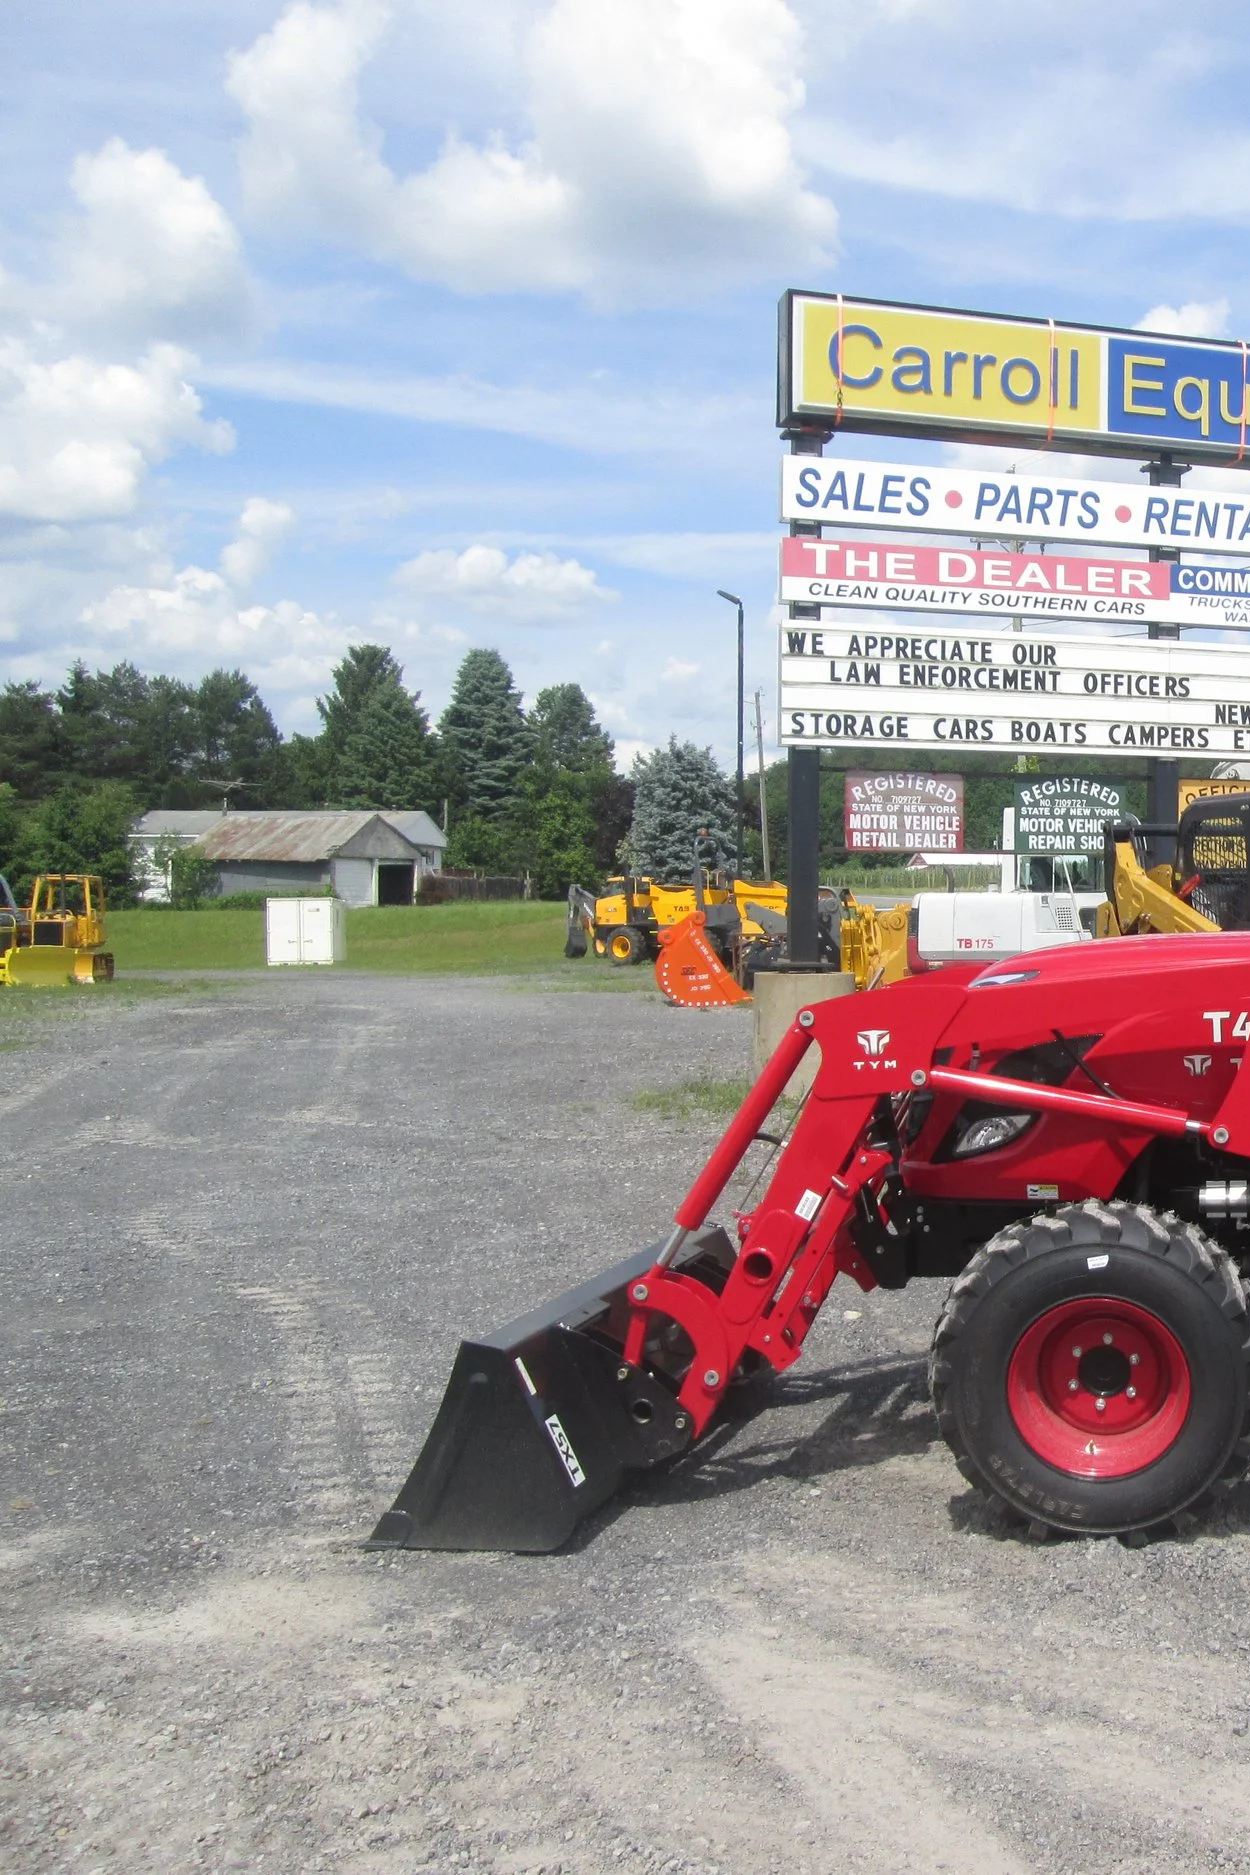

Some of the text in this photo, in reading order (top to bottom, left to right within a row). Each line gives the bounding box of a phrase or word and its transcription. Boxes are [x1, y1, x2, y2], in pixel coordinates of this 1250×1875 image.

[828, 324, 1078, 409] Carroll
[795, 467, 931, 516] SALES
[974, 482, 1100, 530] PARTS
[802, 542, 1152, 596] THE DEALER
[808, 582, 1145, 615] CLEAN QUALITY SOUTHERN CARS
[787, 631, 1057, 665] WE APPRECIATE OUR
[830, 660, 1190, 698] LAW ENFORCEMENT OFFICERS
[791, 712, 909, 738] STORAGE
[933, 717, 993, 741] CARS
[1011, 720, 1087, 744] BOATS
[1108, 724, 1210, 748] CAMPERS
[851, 773, 957, 802] REGISTERED
[1020, 777, 1120, 806] REGISTERED
[891, 795, 921, 803] 7109727
[1054, 799, 1087, 808] 7109727
[851, 803, 957, 814] STATE OF NEW YORK
[1021, 807, 1120, 817] STATE OF NEW YORK
[849, 813, 960, 831] MOTOR VEHICLE
[1019, 817, 1064, 833] MOTOR
[852, 831, 957, 848] RETAIL DEALER
[1028, 834, 1105, 850] REPAIR SHO
[956, 938, 994, 949] TB 175
[853, 1060, 897, 1070] TYM
